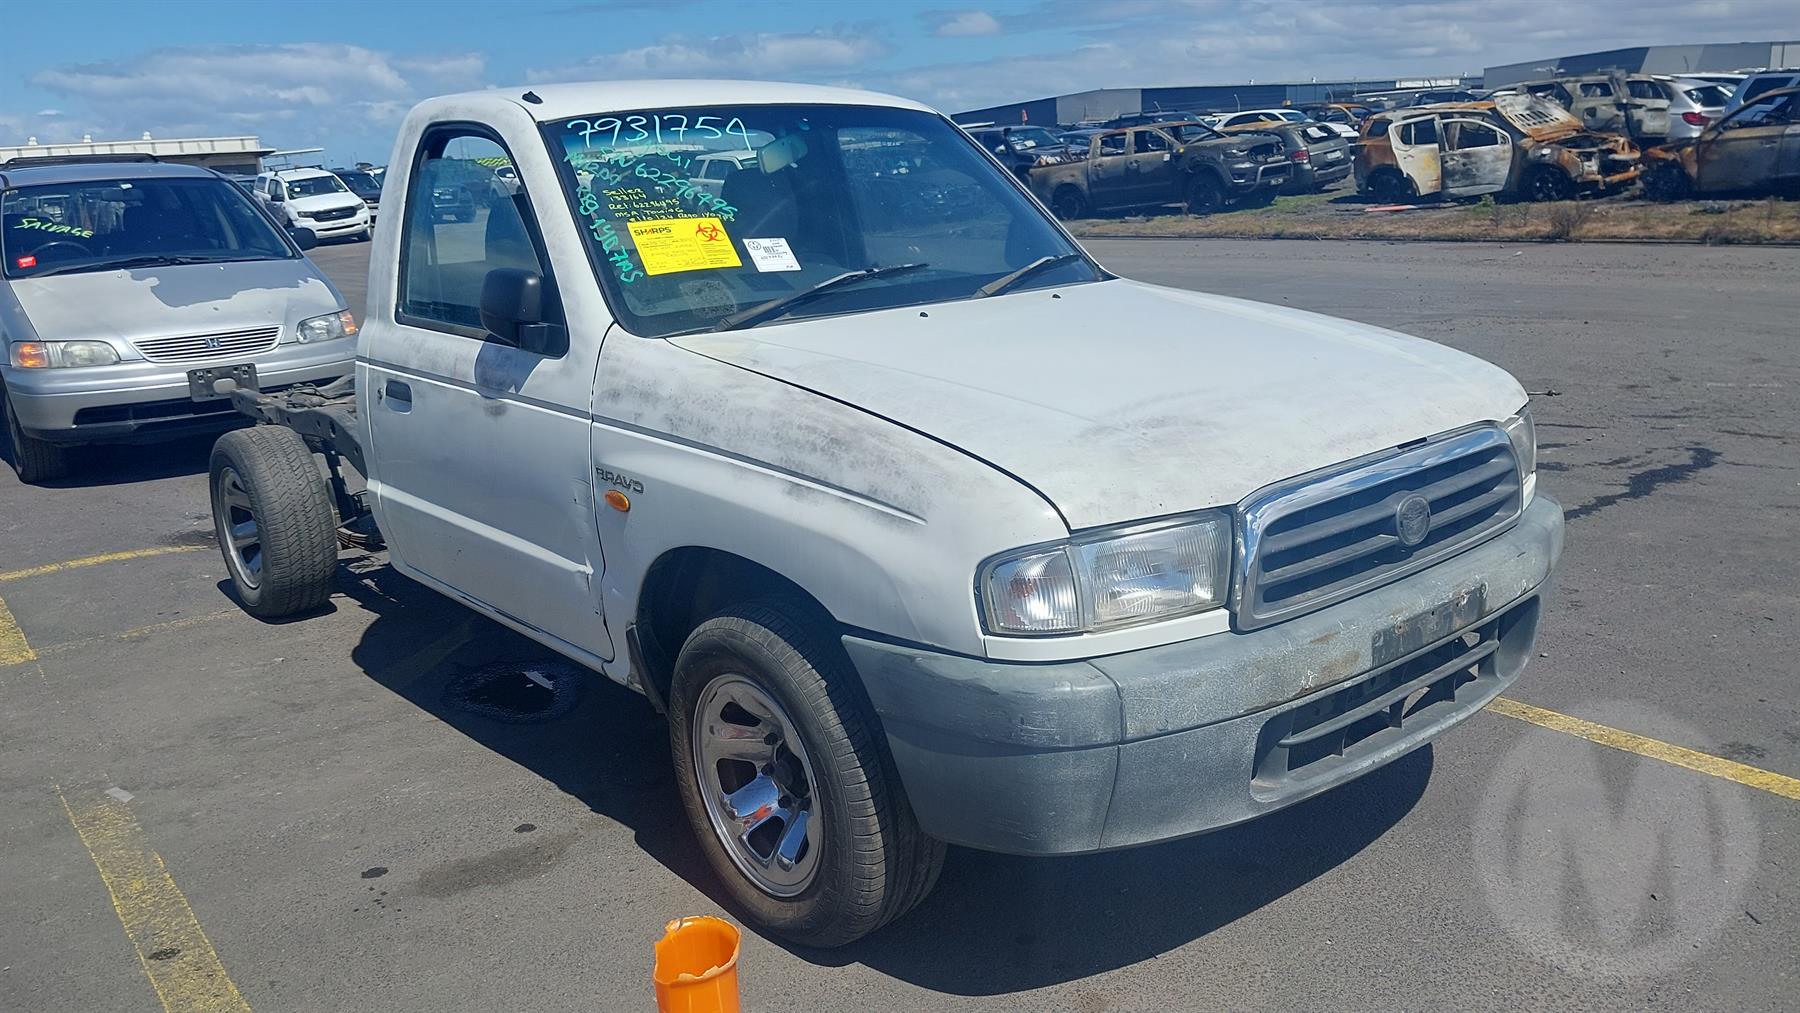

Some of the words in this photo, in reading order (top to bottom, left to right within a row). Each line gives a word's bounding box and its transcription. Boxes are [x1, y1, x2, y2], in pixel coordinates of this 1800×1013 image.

[567, 115, 759, 151] 7931754
[14, 218, 93, 238] SALVAGE
[595, 466, 645, 494] BRAVO
